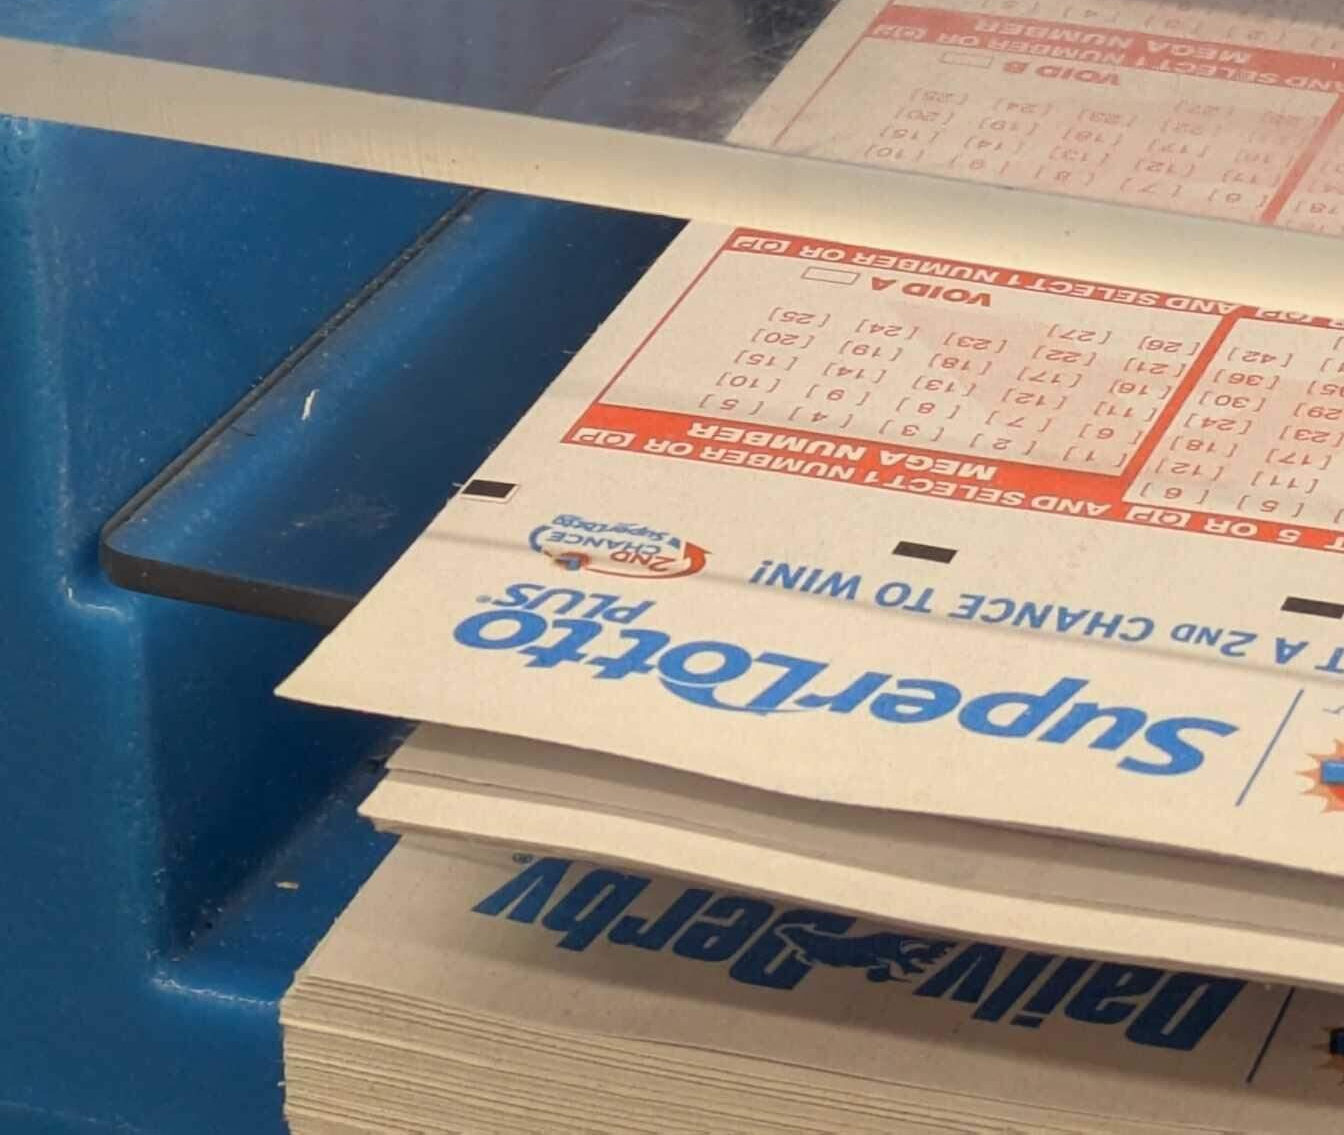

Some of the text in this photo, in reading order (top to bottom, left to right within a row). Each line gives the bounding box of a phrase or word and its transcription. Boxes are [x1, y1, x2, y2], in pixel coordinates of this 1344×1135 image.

[976, 18, 1251, 65] MEGA NUMBER
[799, 245, 846, 263] OR
[852, 251, 999, 286] NUMBER
[870, 278, 994, 308] VOID A
[1033, 276, 1158, 308] SELECT
[1168, 295, 1237, 315] AND
[643, 436, 695, 459] OR
[687, 421, 997, 481] MEGA NUMBER
[701, 444, 855, 482] NUMBER
[888, 472, 1026, 507] SELECT
[1031, 494, 1106, 517] AND
[1203, 515, 1258, 538] OR
[1276, 526, 1302, 545] 5
[545, 532, 662, 555] CHANCE
[610, 551, 677, 572] 2ND
[751, 560, 862, 600] WIN!
[875, 579, 949, 613] TO
[490, 582, 655, 625] PLUS
[953, 592, 1156, 643] CHANCE
[1170, 622, 1257, 658] 2ND
[1271, 639, 1313, 665] A
[468, 857, 1251, 1051] Daily Derby
